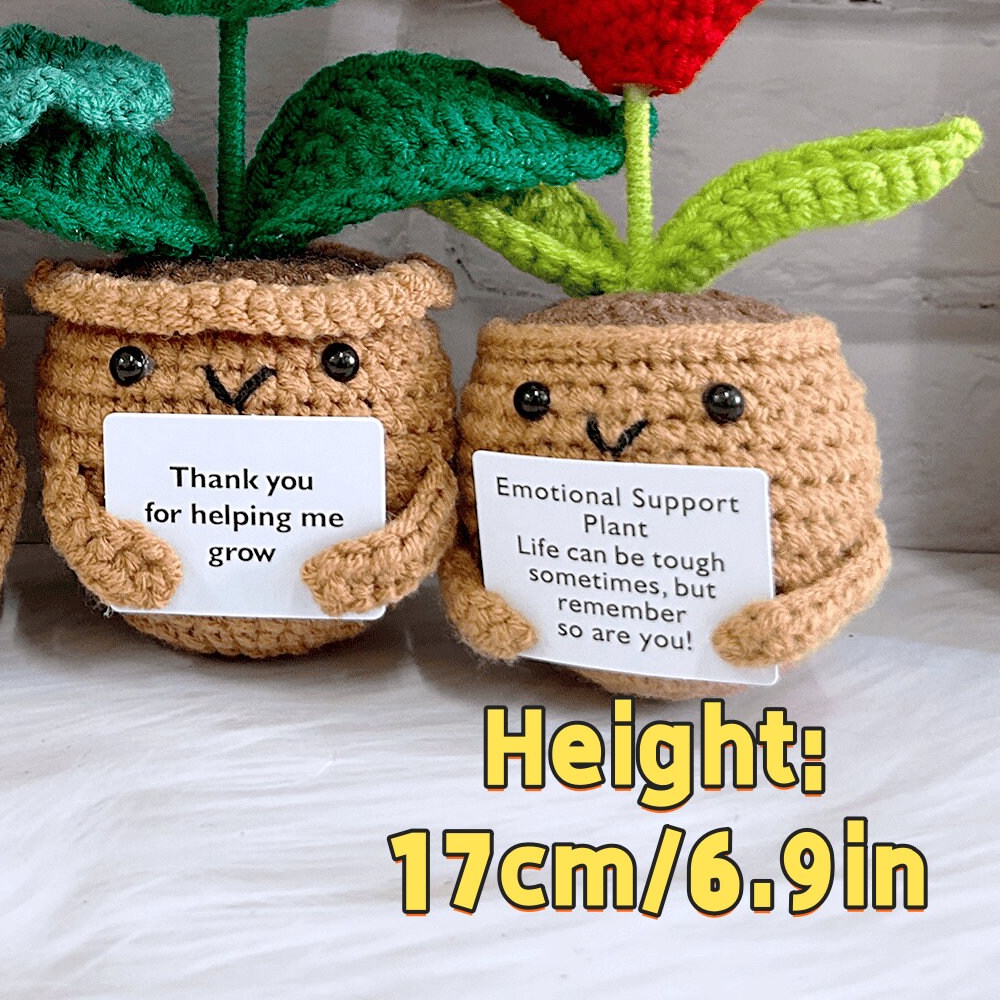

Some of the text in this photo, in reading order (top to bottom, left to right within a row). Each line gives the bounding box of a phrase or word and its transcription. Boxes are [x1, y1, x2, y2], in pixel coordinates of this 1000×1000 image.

[170, 466, 313, 496] Thank you
[496, 477, 739, 516] Emotional Support
[145, 502, 344, 533] for helping me
[584, 514, 648, 538] Plant
[208, 546, 276, 568] grow
[517, 535, 725, 577] Life can be tough
[529, 568, 716, 599] sometimes, but
[558, 597, 687, 624] remember
[558, 622, 692, 652] so are you!
